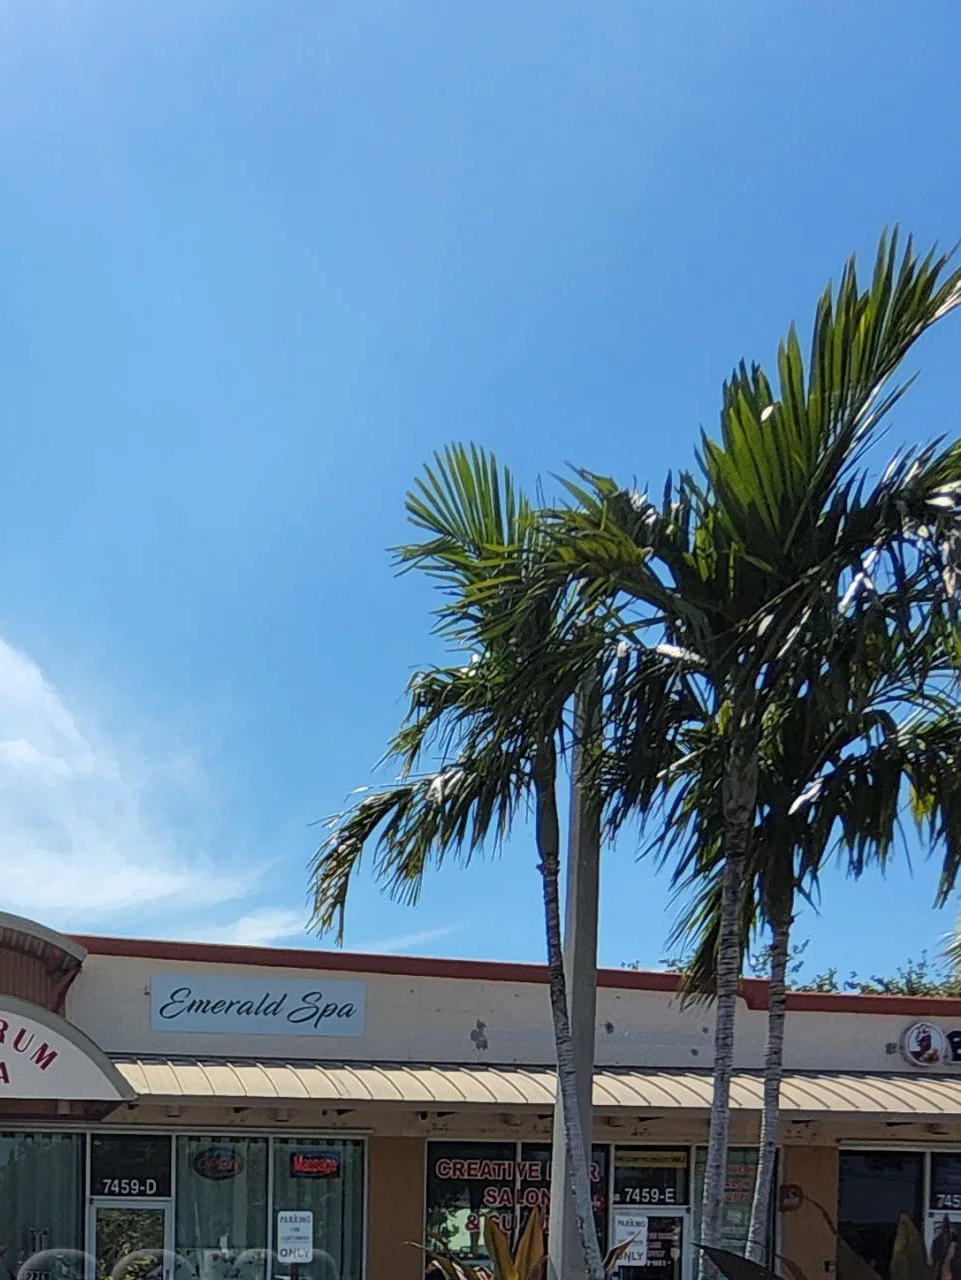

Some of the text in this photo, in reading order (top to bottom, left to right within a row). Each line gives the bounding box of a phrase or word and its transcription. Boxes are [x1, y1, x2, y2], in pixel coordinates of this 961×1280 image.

[159, 987, 357, 1029] Emerald Spa
[436, 1159, 543, 1181] CREATIVE
[102, 1178, 157, 1194] 7459-D
[483, 1187, 552, 1208] SALON
[624, 1188, 675, 1202] 7459-E
[279, 1215, 311, 1224] PARKING
[280, 1249, 310, 1259] ONLY
